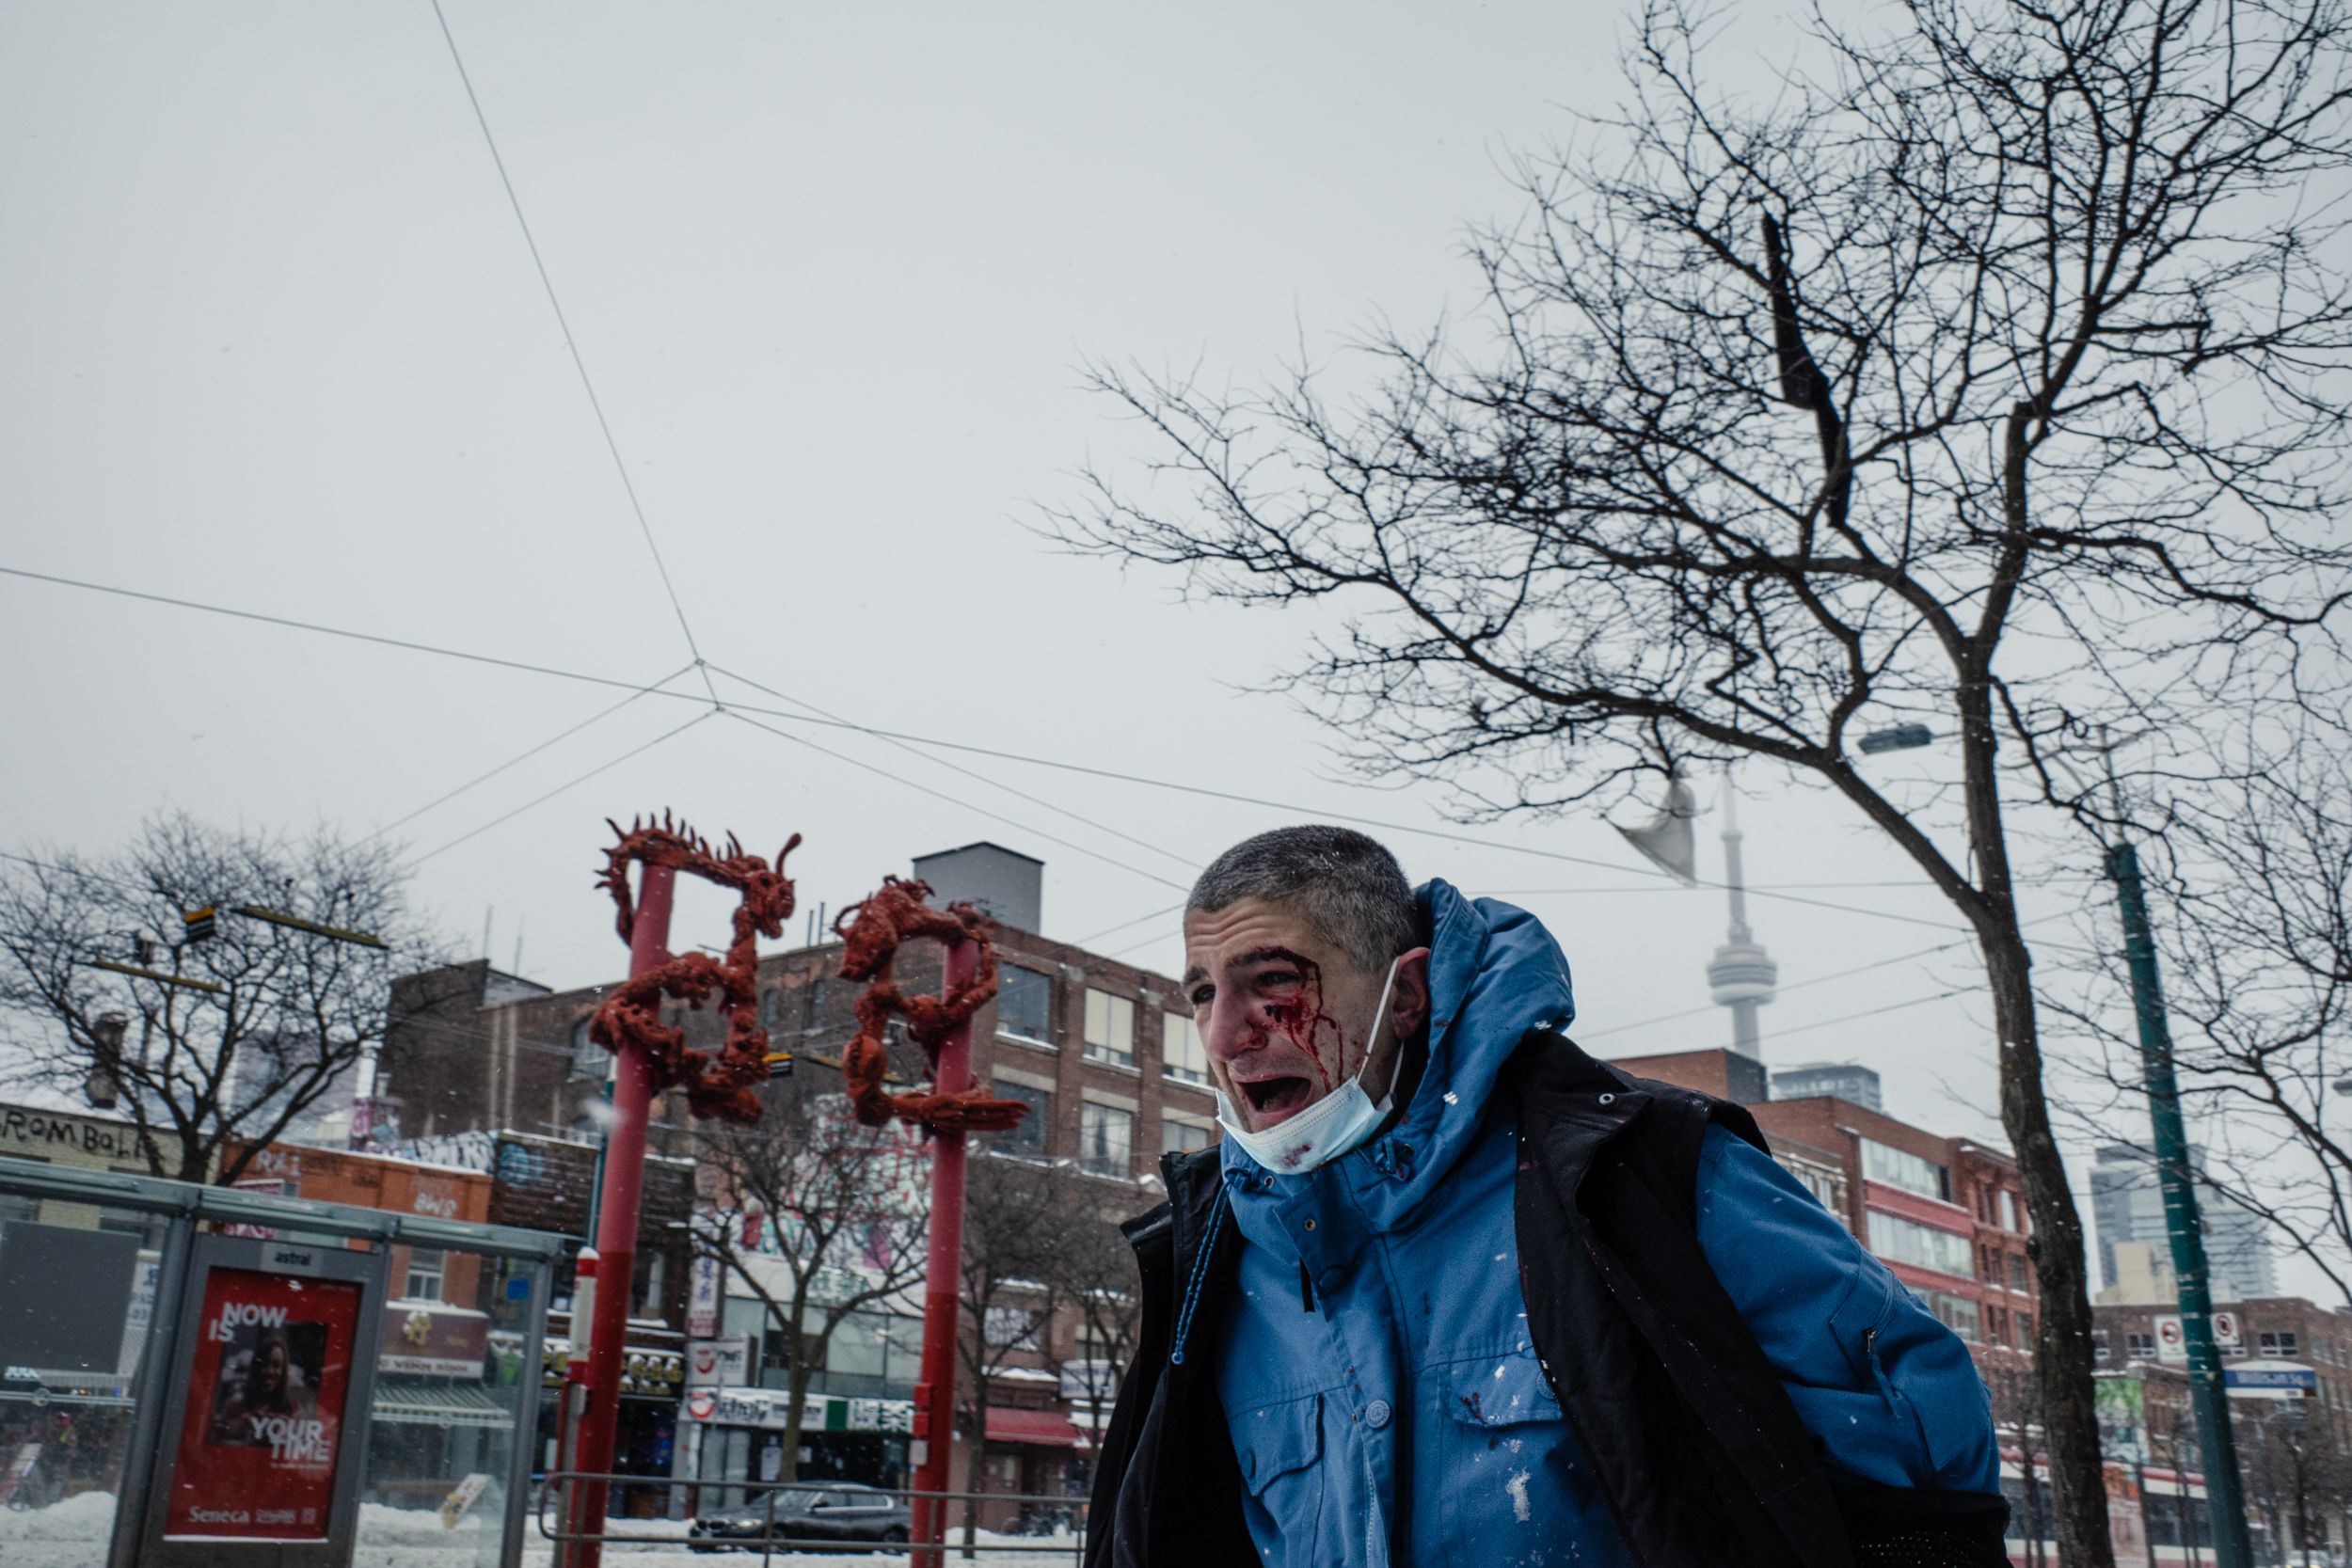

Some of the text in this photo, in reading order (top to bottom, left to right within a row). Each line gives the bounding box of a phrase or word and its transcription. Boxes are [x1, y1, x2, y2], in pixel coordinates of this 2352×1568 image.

[274, 1252, 311, 1266] astral
[223, 1302, 288, 1328] NOW
[209, 1319, 235, 1342] IS
[251, 1418, 323, 1442] YOUR
[271, 1438, 330, 1461] TIME
[189, 1506, 250, 1523] Seneca
